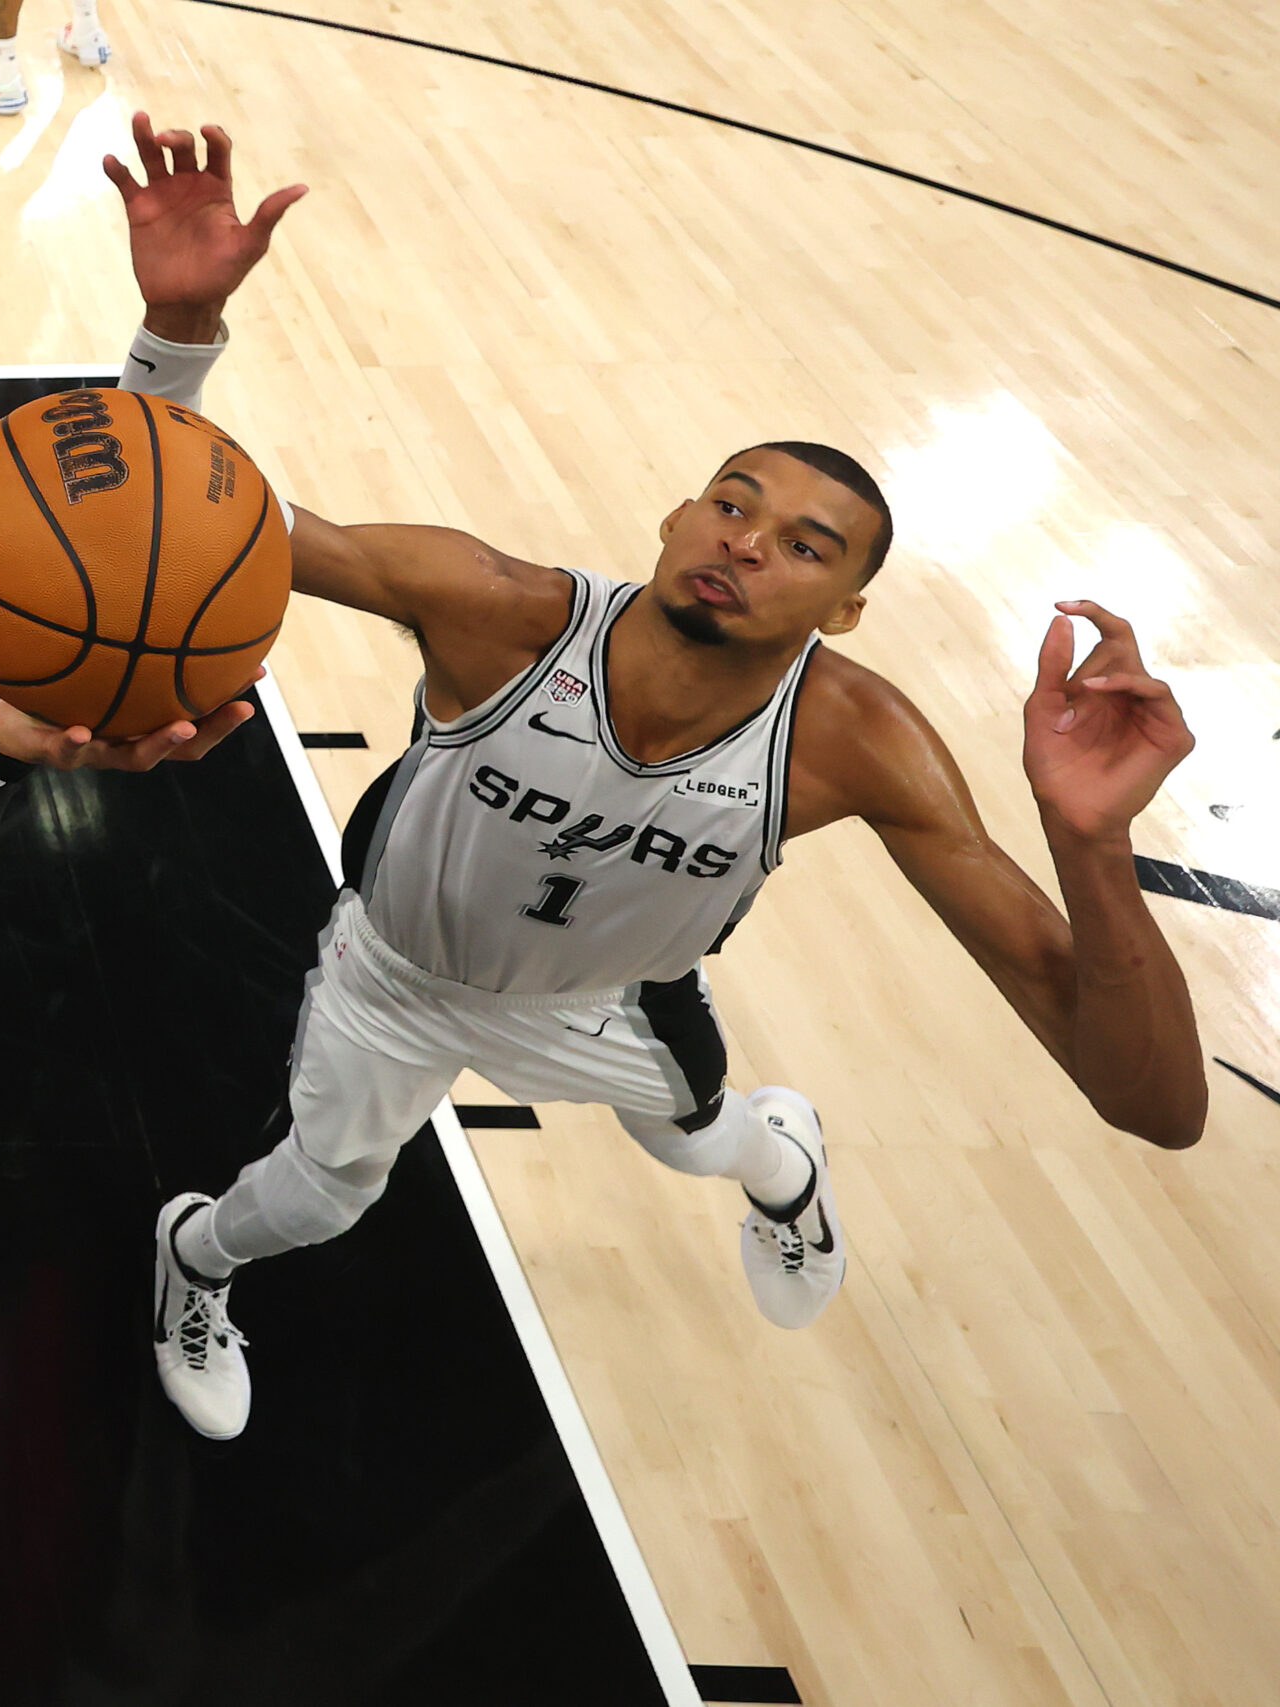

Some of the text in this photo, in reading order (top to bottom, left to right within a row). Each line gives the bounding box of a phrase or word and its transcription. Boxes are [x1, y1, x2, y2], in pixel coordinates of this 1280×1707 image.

[41, 389, 129, 505] Wils
[206, 471, 223, 504] OFFICIAL
[556, 670, 583, 693] USA
[686, 779, 748, 800] LEDGER
[469, 765, 738, 879] SPURS
[520, 872, 586, 929] 1
